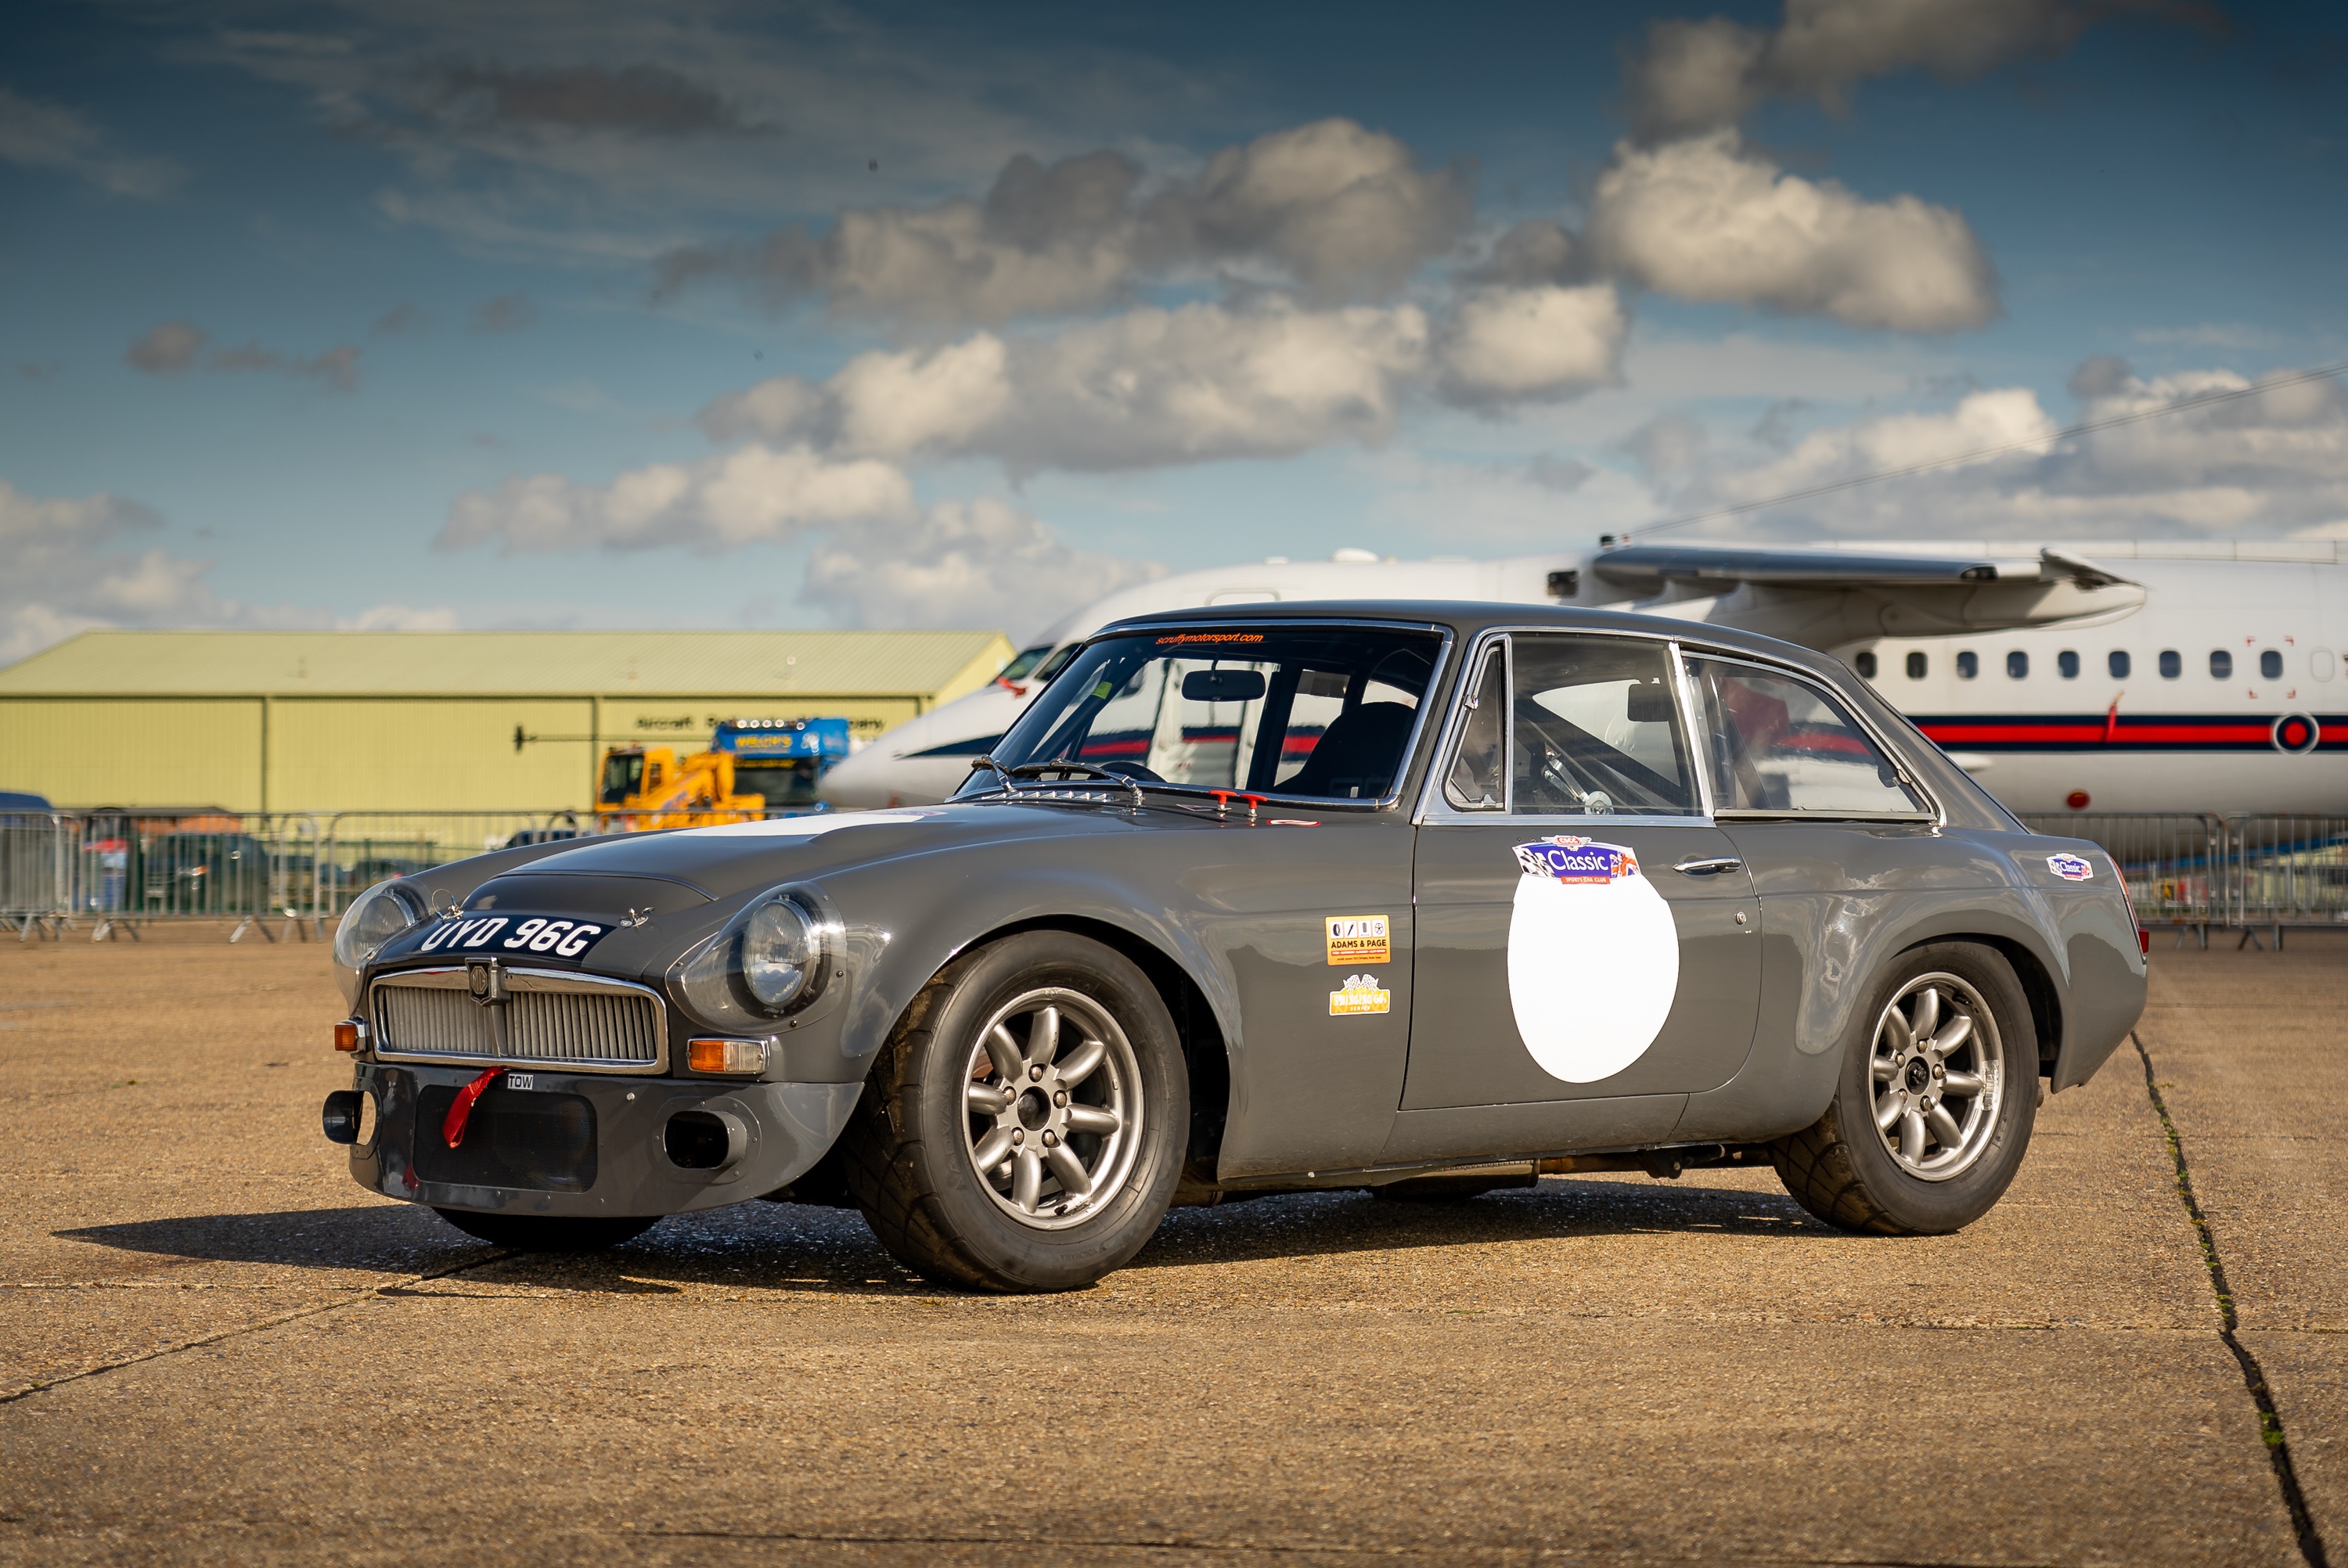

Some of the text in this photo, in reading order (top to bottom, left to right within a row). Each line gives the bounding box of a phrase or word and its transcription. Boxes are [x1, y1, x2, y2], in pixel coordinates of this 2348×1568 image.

[1155, 632, 1264, 644] scruffymotorsport.com
[1547, 850, 1609, 870] Classic
[2059, 861, 2082, 873] Classic
[420, 918, 601, 957] UYD 96G
[509, 1076, 533, 1088] TOW
